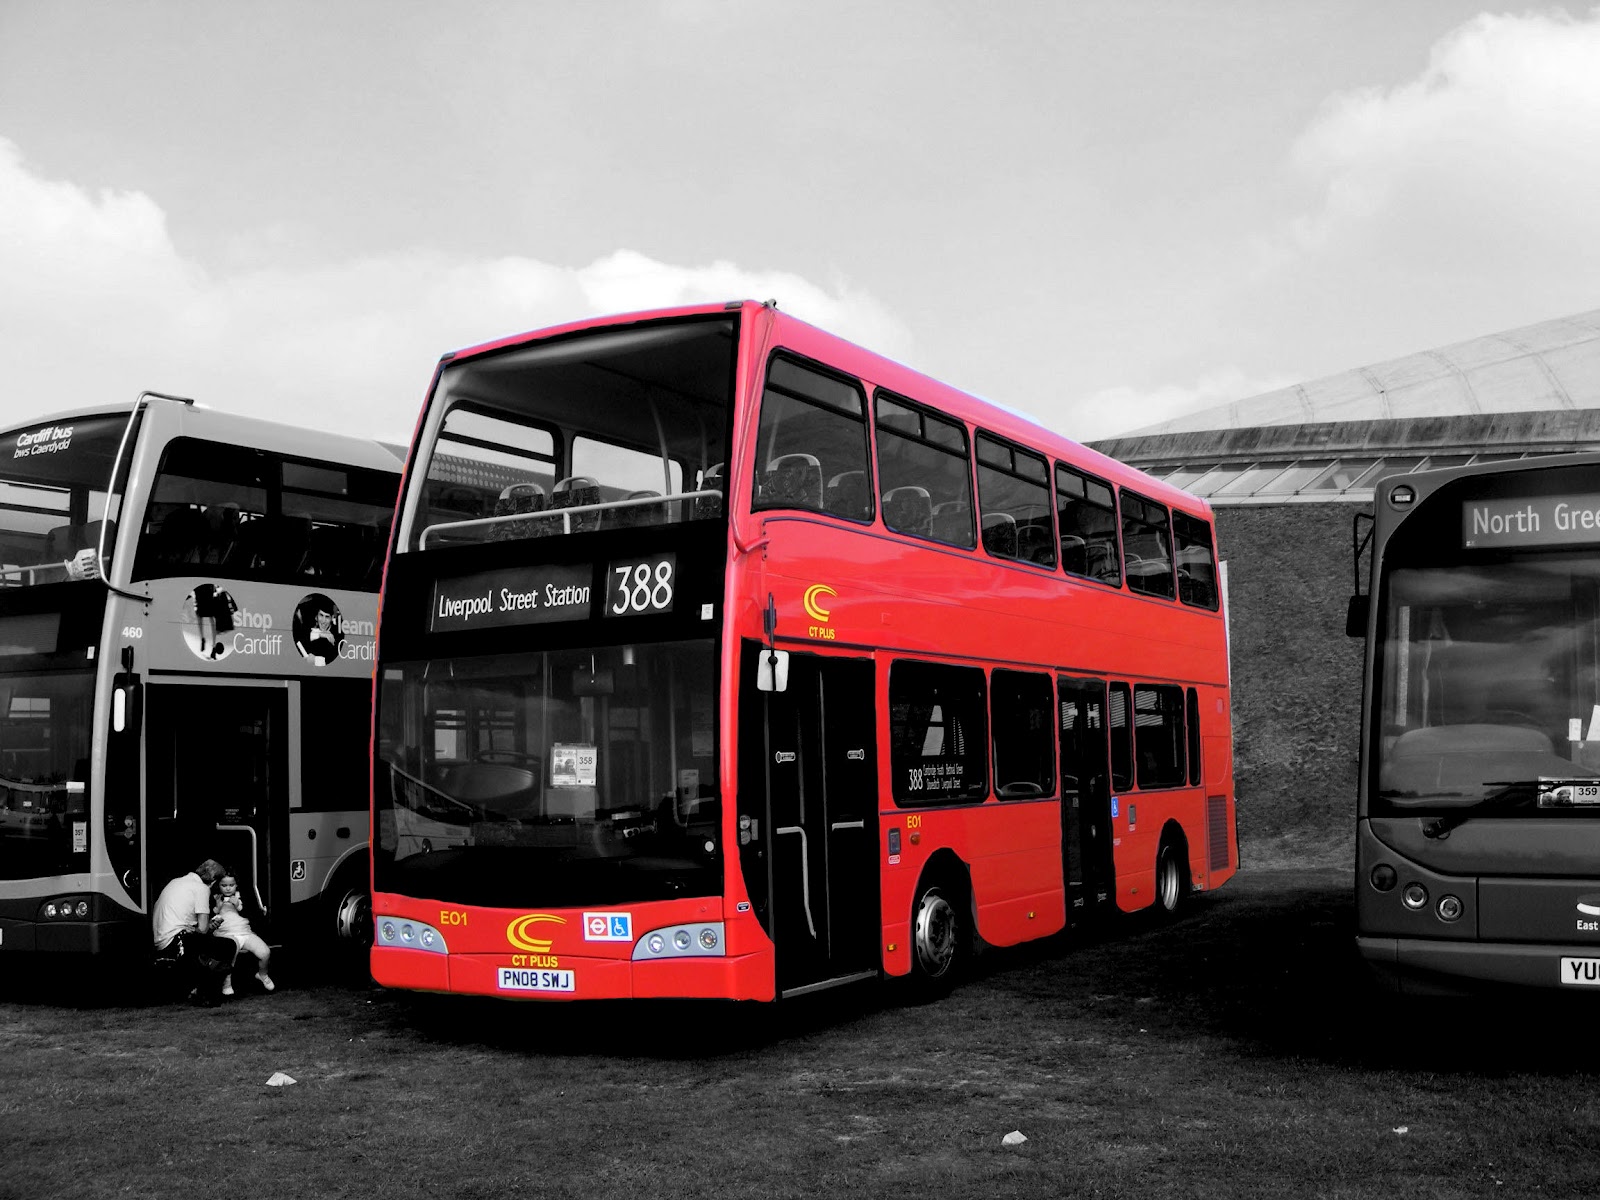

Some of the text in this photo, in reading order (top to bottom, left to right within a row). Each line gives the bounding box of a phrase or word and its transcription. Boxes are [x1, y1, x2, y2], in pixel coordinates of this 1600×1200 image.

[16, 426, 74, 447] Cardiff bus
[13, 438, 71, 459] bws Caerdydd
[1473, 505, 1540, 535] North
[612, 560, 673, 615] 388
[438, 583, 590, 621] Liverpool Street Station
[233, 608, 273, 633] shop
[122, 626, 143, 639] 460
[808, 626, 836, 640] CT PLUS
[233, 633, 283, 656] Cardiff
[337, 639, 378, 661] Cardif
[579, 756, 593, 765] 358
[908, 768, 923, 791] 388
[1578, 787, 1598, 796] 359
[1576, 920, 1598, 930] East
[512, 955, 558, 968] CT PLUS
[1571, 961, 1600, 980] YU
[504, 971, 569, 988] PN08 SWJ
